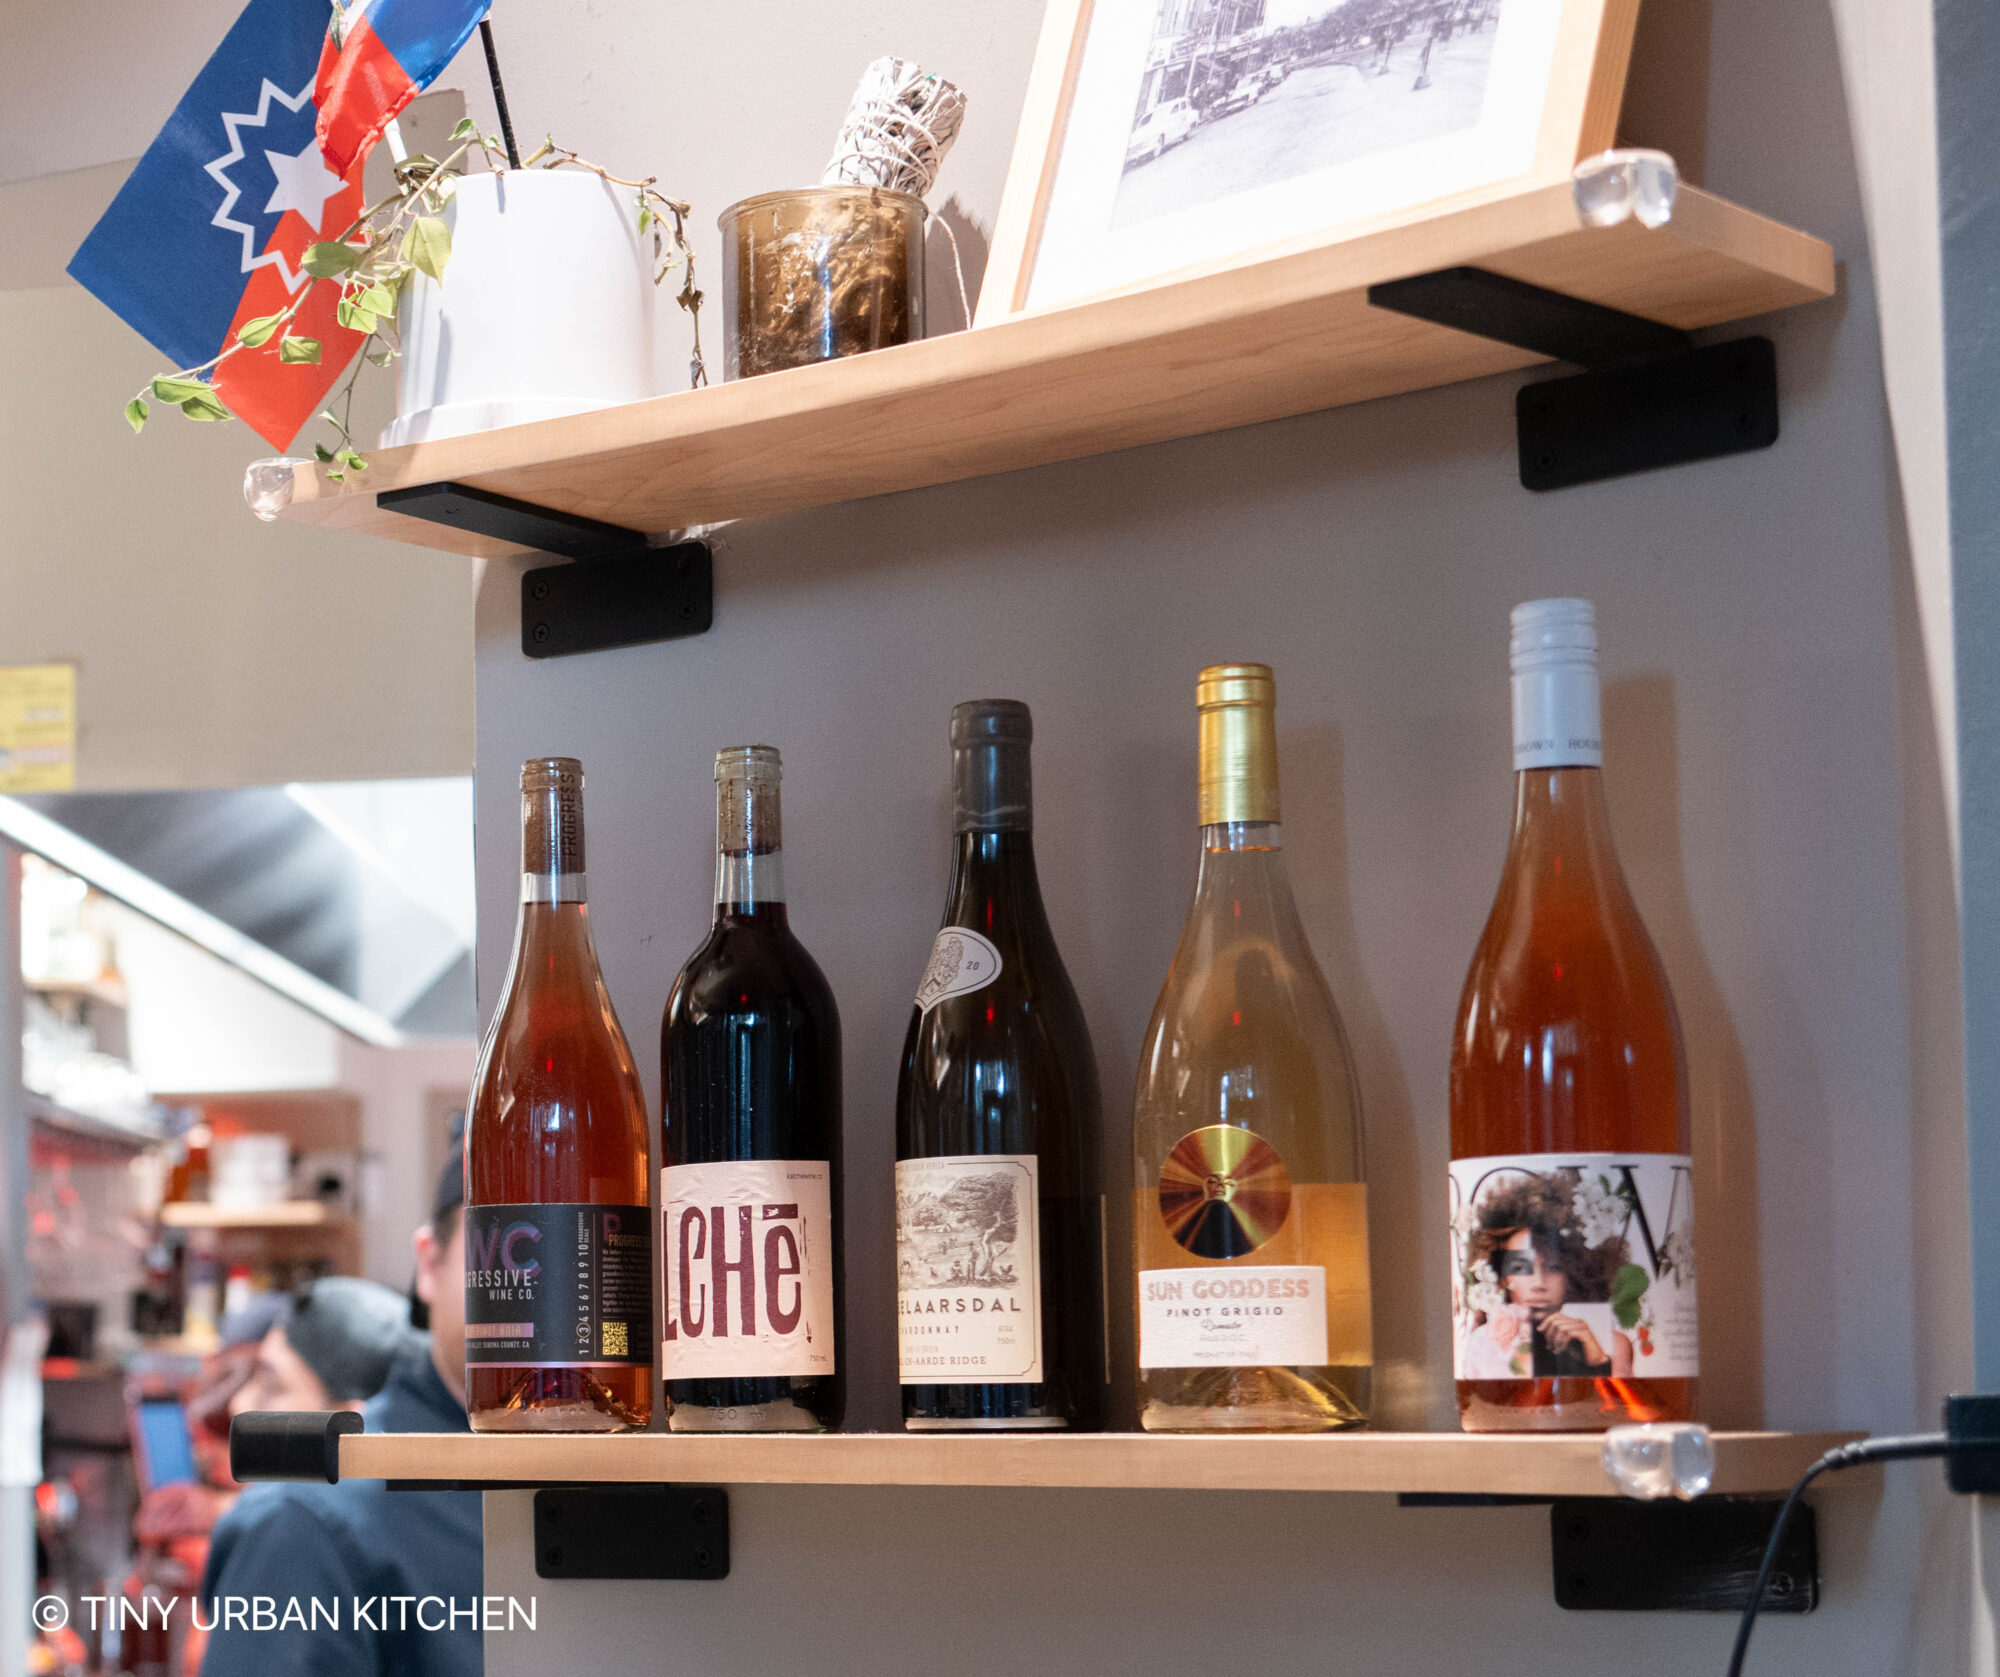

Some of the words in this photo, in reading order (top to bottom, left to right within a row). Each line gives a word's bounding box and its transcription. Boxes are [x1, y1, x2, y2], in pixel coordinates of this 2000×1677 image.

[966, 960, 980, 971] 20
[578, 1244, 589, 1256] 10
[489, 1289, 513, 1300] WINE
[519, 1288, 534, 1300] CO.
[1147, 1280, 1182, 1301] SUN
[1192, 1278, 1310, 1299] GODDESS
[1167, 1307, 1211, 1317] PINOT
[1221, 1306, 1284, 1316] GRIGIO
[579, 1326, 589, 1334] 3
[579, 1337, 589, 1345] 2
[579, 1347, 589, 1355] 1
[950, 1356, 987, 1365] RIDGE
